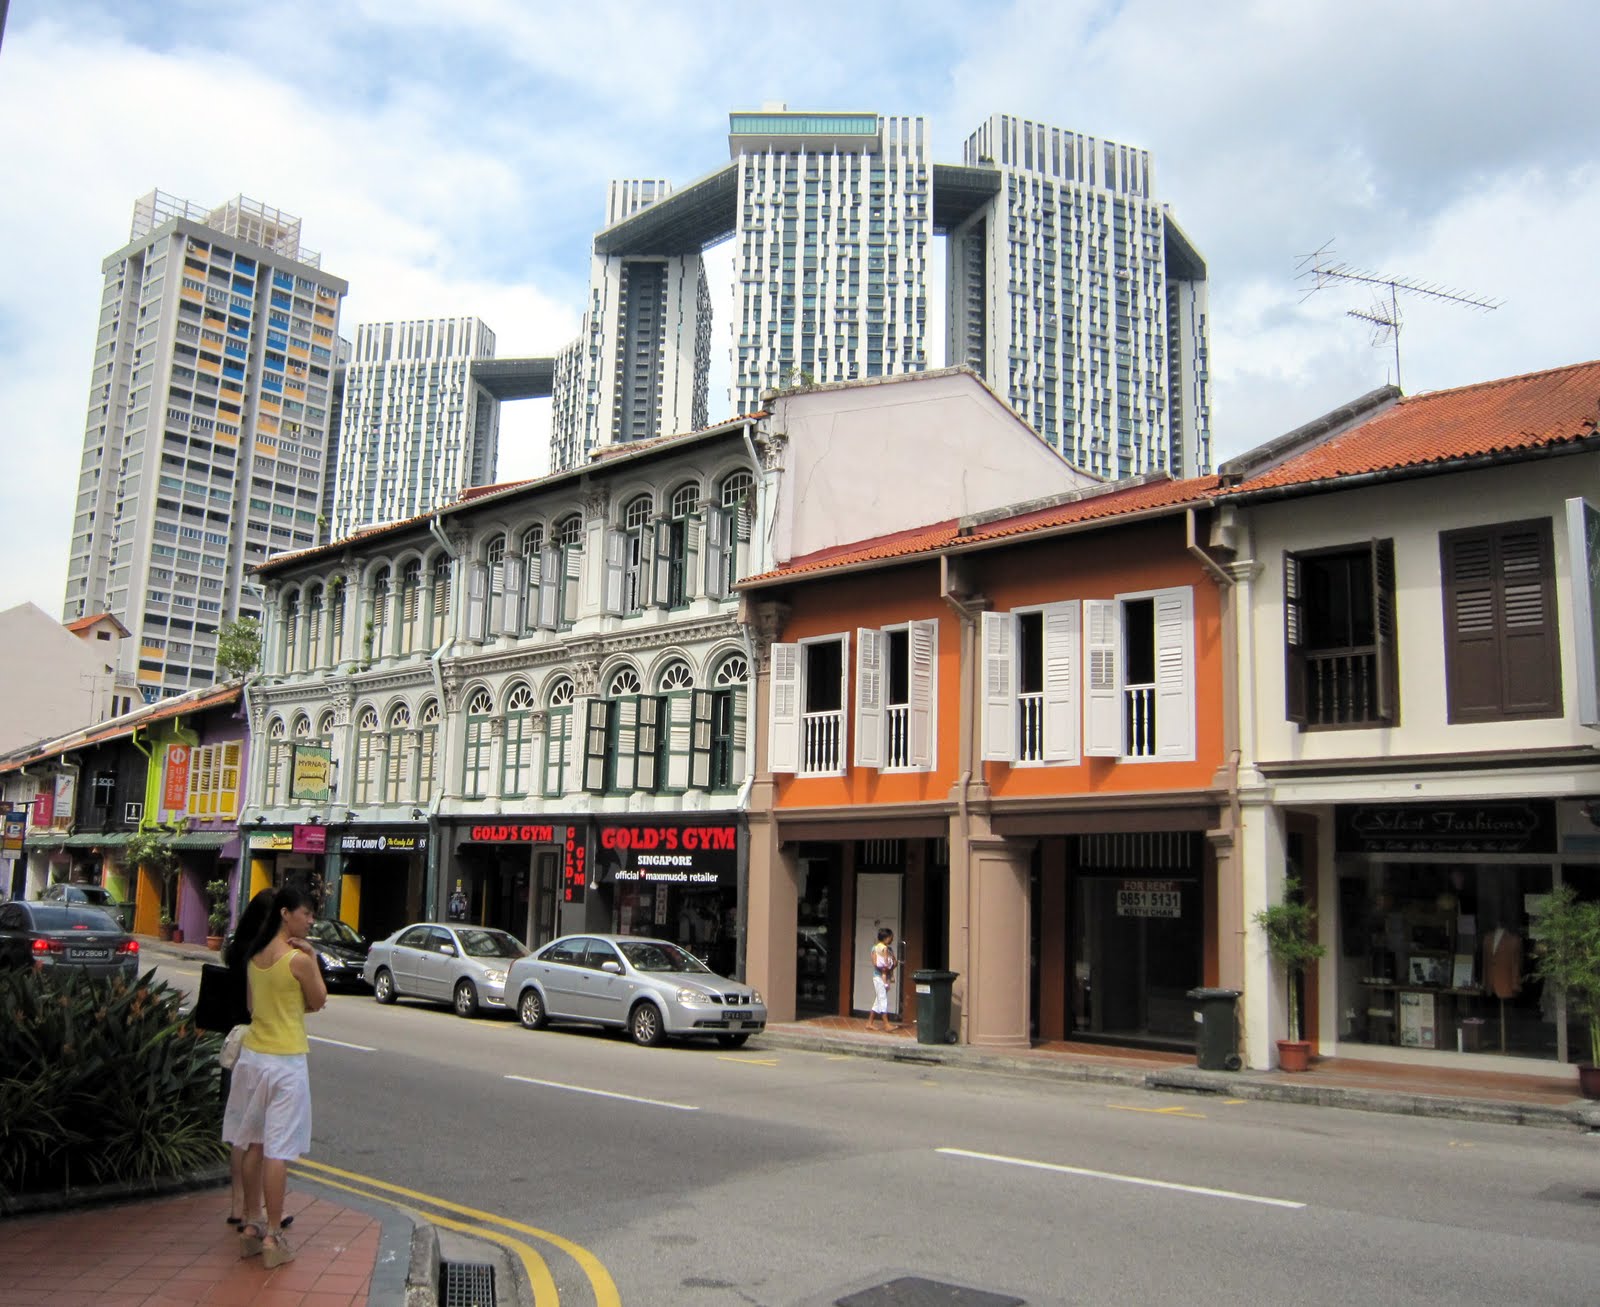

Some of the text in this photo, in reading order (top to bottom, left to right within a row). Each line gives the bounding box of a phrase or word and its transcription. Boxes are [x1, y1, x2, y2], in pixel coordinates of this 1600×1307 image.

[1433, 811, 1523, 832] Fashions
[472, 825, 552, 841] GOLD'S GYM
[601, 827, 736, 850] GOLD'S GYM
[342, 839, 378, 849] MADE IN CANDY
[566, 826, 576, 901] GOLD'S
[574, 846, 585, 886] GYM
[637, 855, 692, 866] SINGAPORE
[614, 870, 718, 883] official maximuscle retailer
[1124, 880, 1173, 891] FOR RENT
[1120, 892, 1178, 907] 9851 5131
